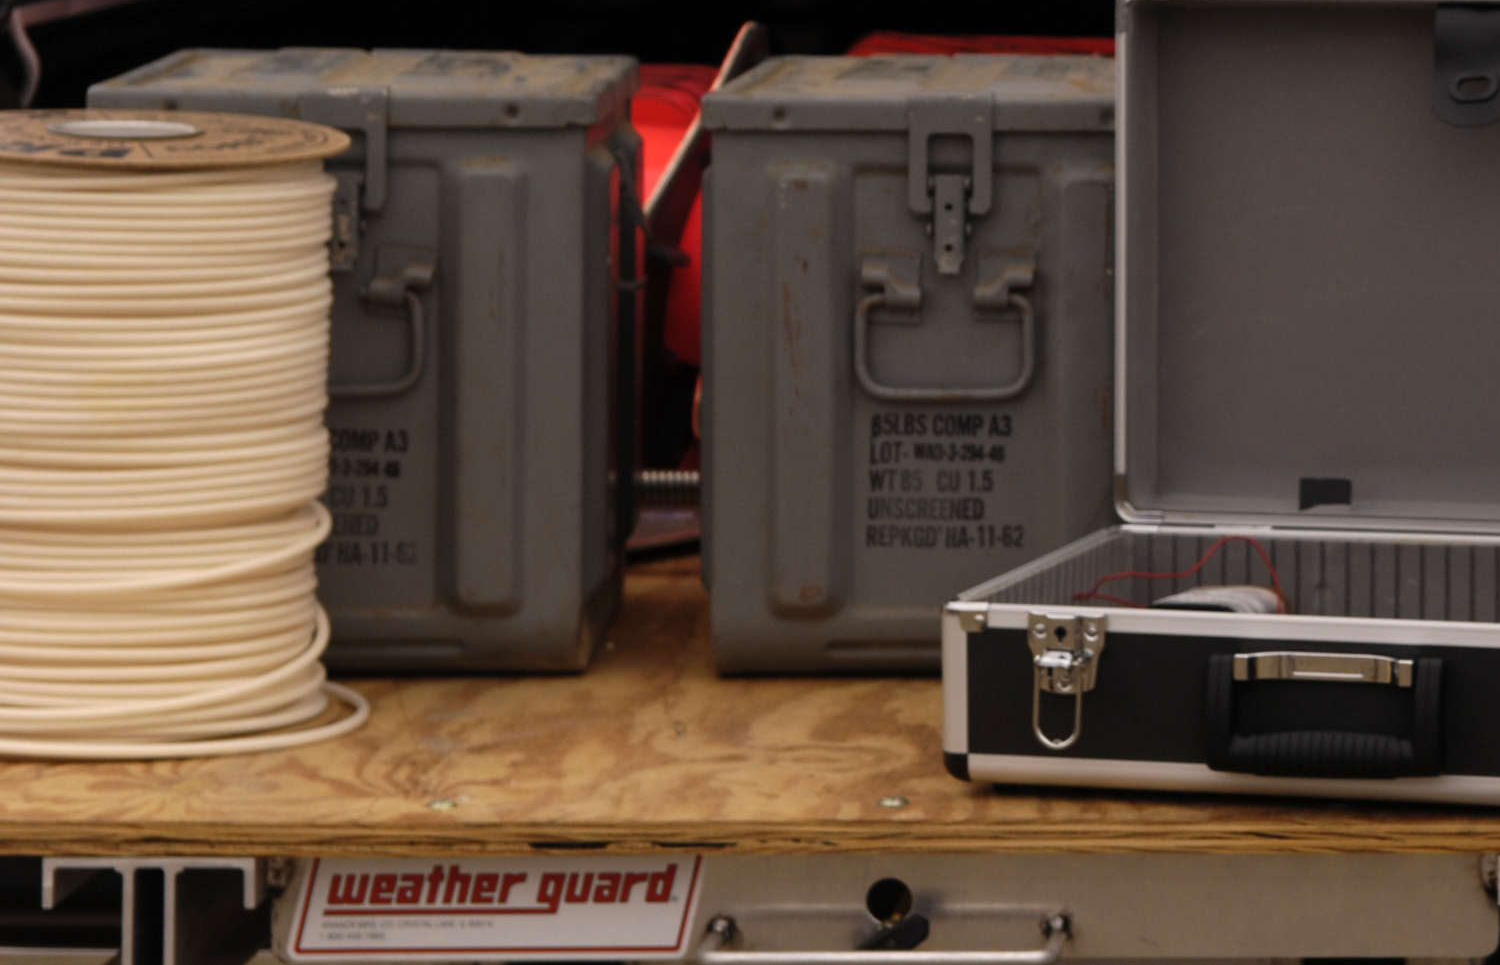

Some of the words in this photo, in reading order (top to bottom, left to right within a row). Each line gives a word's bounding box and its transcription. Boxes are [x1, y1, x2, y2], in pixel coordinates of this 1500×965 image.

[932, 414, 984, 436] COMP
[989, 415, 1012, 436] A3
[384, 429, 409, 453] A3
[869, 469, 897, 492] WT
[936, 470, 960, 492] CU
[968, 469, 993, 492] 1.5
[867, 497, 985, 520] UNSCREENED
[327, 865, 527, 904] weather
[537, 863, 677, 914] guard
